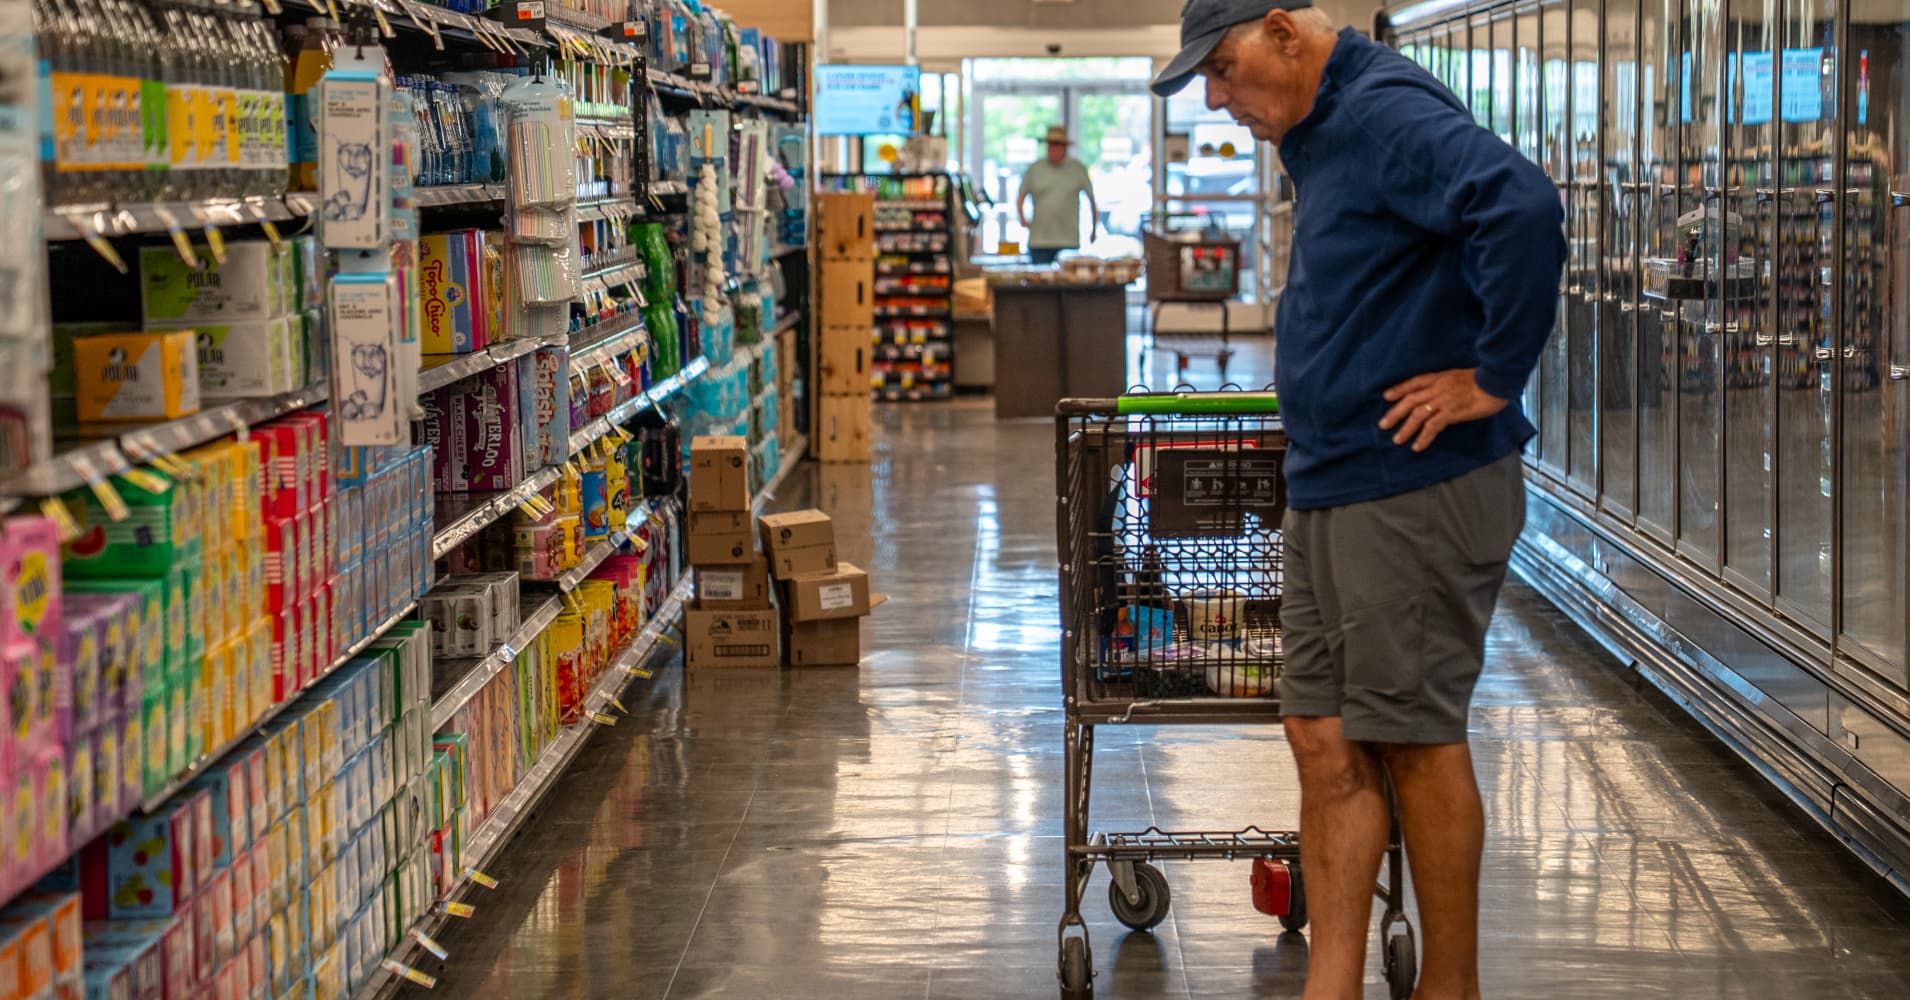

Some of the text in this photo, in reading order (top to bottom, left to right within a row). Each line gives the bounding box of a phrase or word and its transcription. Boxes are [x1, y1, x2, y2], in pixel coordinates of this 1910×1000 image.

[187, 272, 222, 288] POLAR
[423, 259, 446, 337] Topo Chico
[101, 365, 138, 384] POLAR
[199, 349, 224, 366] OLAR
[535, 359, 553, 424] splash
[455, 397, 465, 464] BLACK CHERRY
